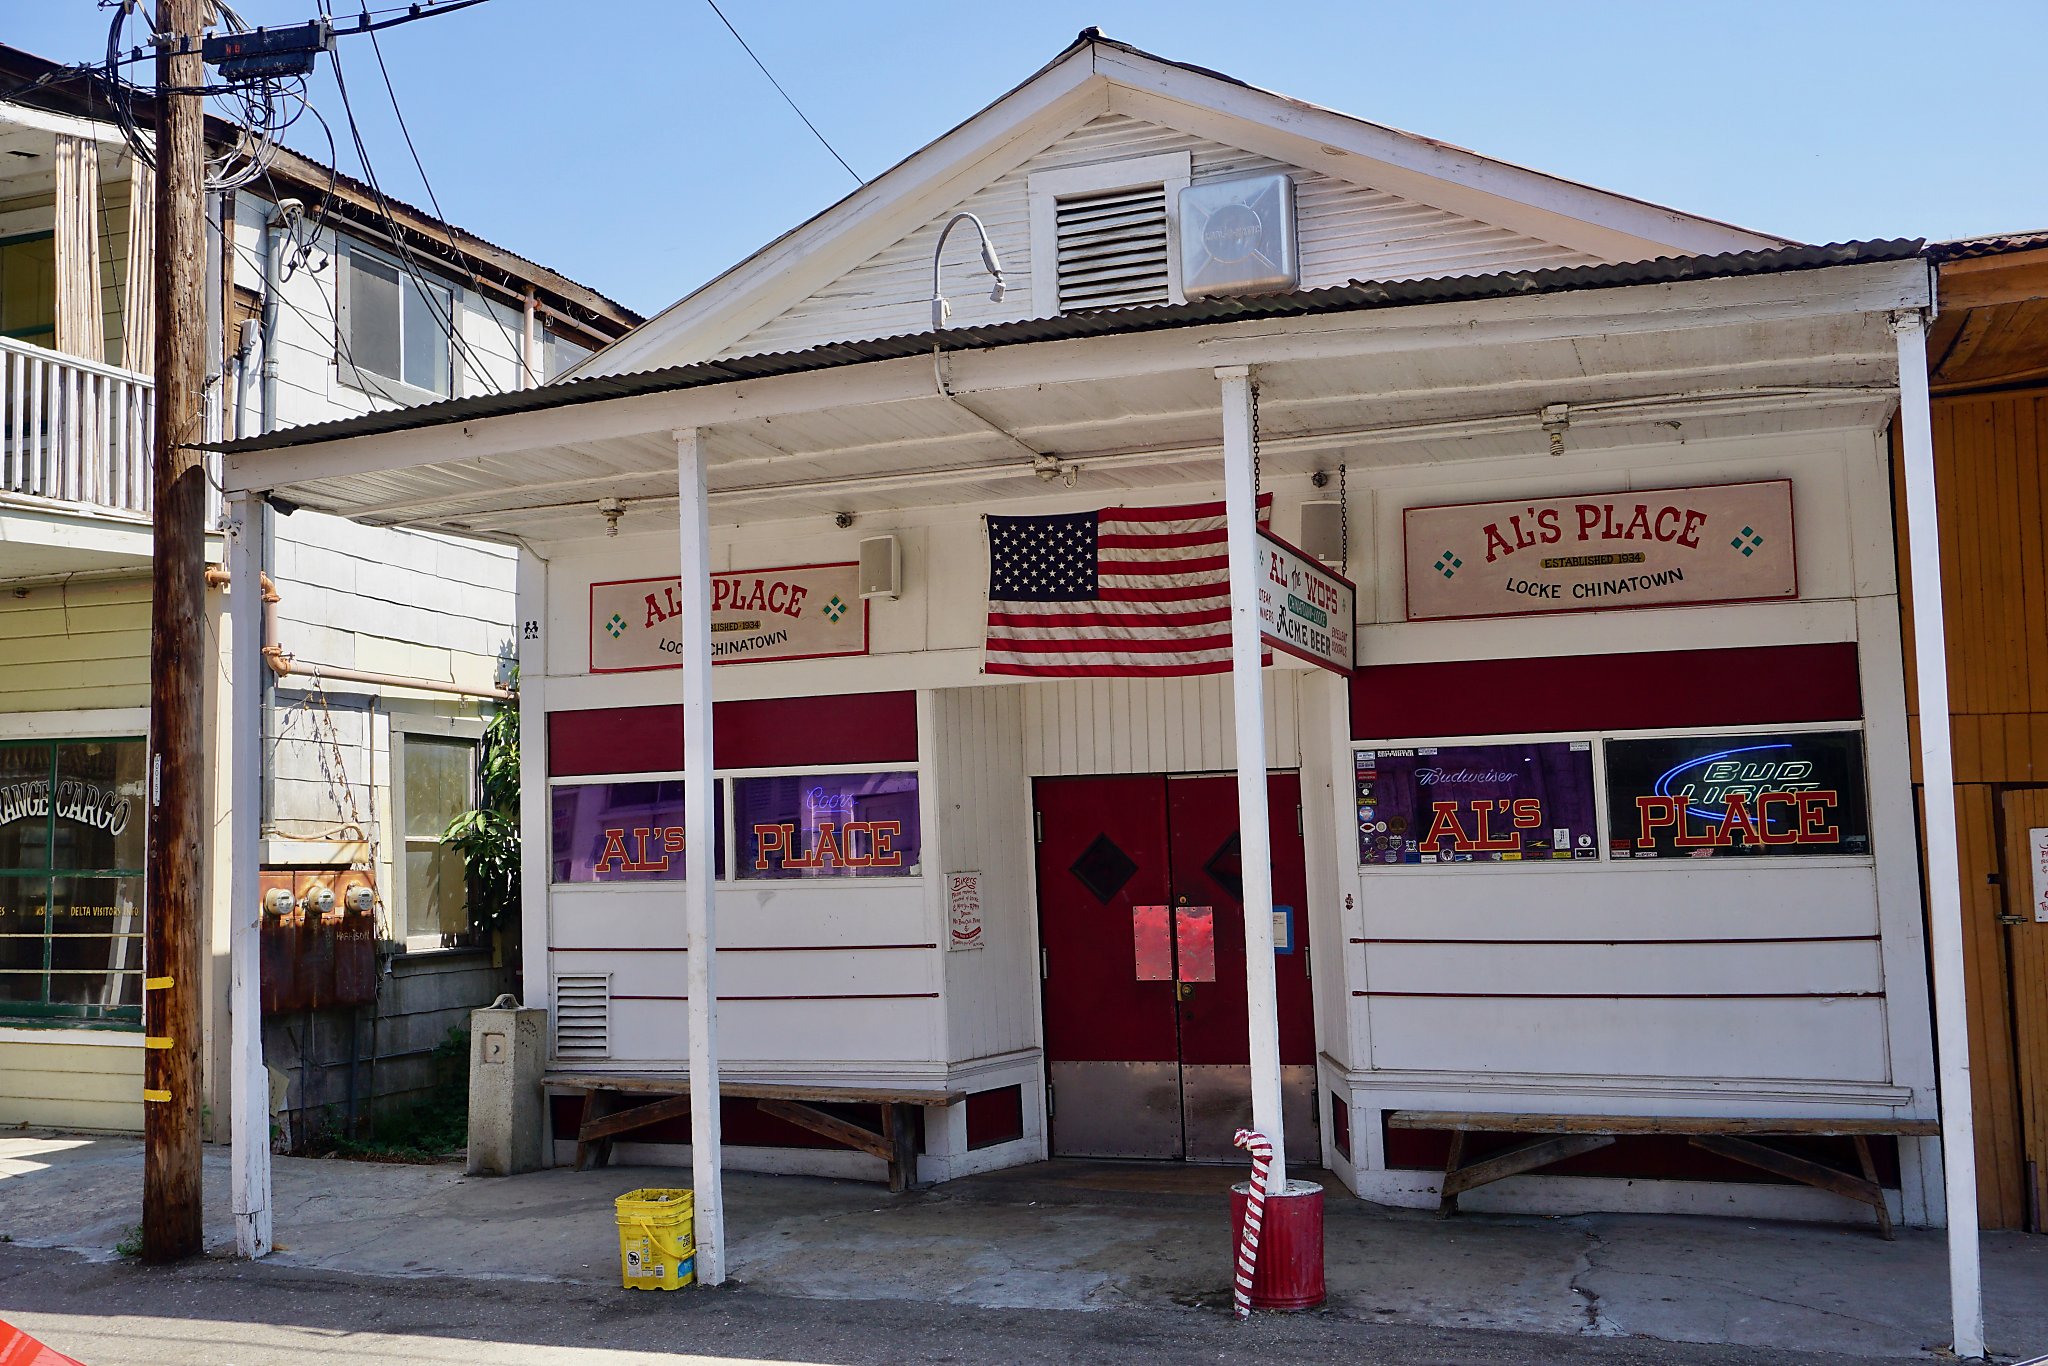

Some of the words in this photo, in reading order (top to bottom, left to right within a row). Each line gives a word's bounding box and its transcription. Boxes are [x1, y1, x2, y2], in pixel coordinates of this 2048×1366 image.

[1483, 507, 1562, 563] AL'S
[1575, 504, 1708, 550] PLACE
[1269, 551, 1288, 588] AL
[1291, 564, 1302, 592] the
[1545, 554, 1614, 569] ESTABLISHED
[1618, 552, 1642, 564] 1934
[1506, 577, 1562, 599] LOCKE
[1572, 567, 1684, 599] CHINATOWN
[644, 581, 683, 629] AL'
[711, 579, 808, 619] PLACE
[659, 638, 683, 655] LOC
[710, 629, 788, 656] CHINATOWN
[711, 622, 739, 632] BLISHED
[742, 621, 760, 631] 1934
[1276, 604, 1309, 647] ACME
[1310, 628, 1331, 656] BEER
[1414, 767, 1519, 786] Budweiser
[1703, 760, 1813, 783] BUD
[0, 780, 49, 826] ANGE
[56, 780, 132, 836] CARGO
[806, 786, 859, 810] Coors
[1418, 798, 1542, 853] AL'S
[1635, 790, 1840, 848] PLACE
[595, 826, 686, 873] AL'S
[754, 820, 901, 870] PLACE
[70, 906, 91, 917] DELTA
[92, 906, 121, 917] VISITORS
